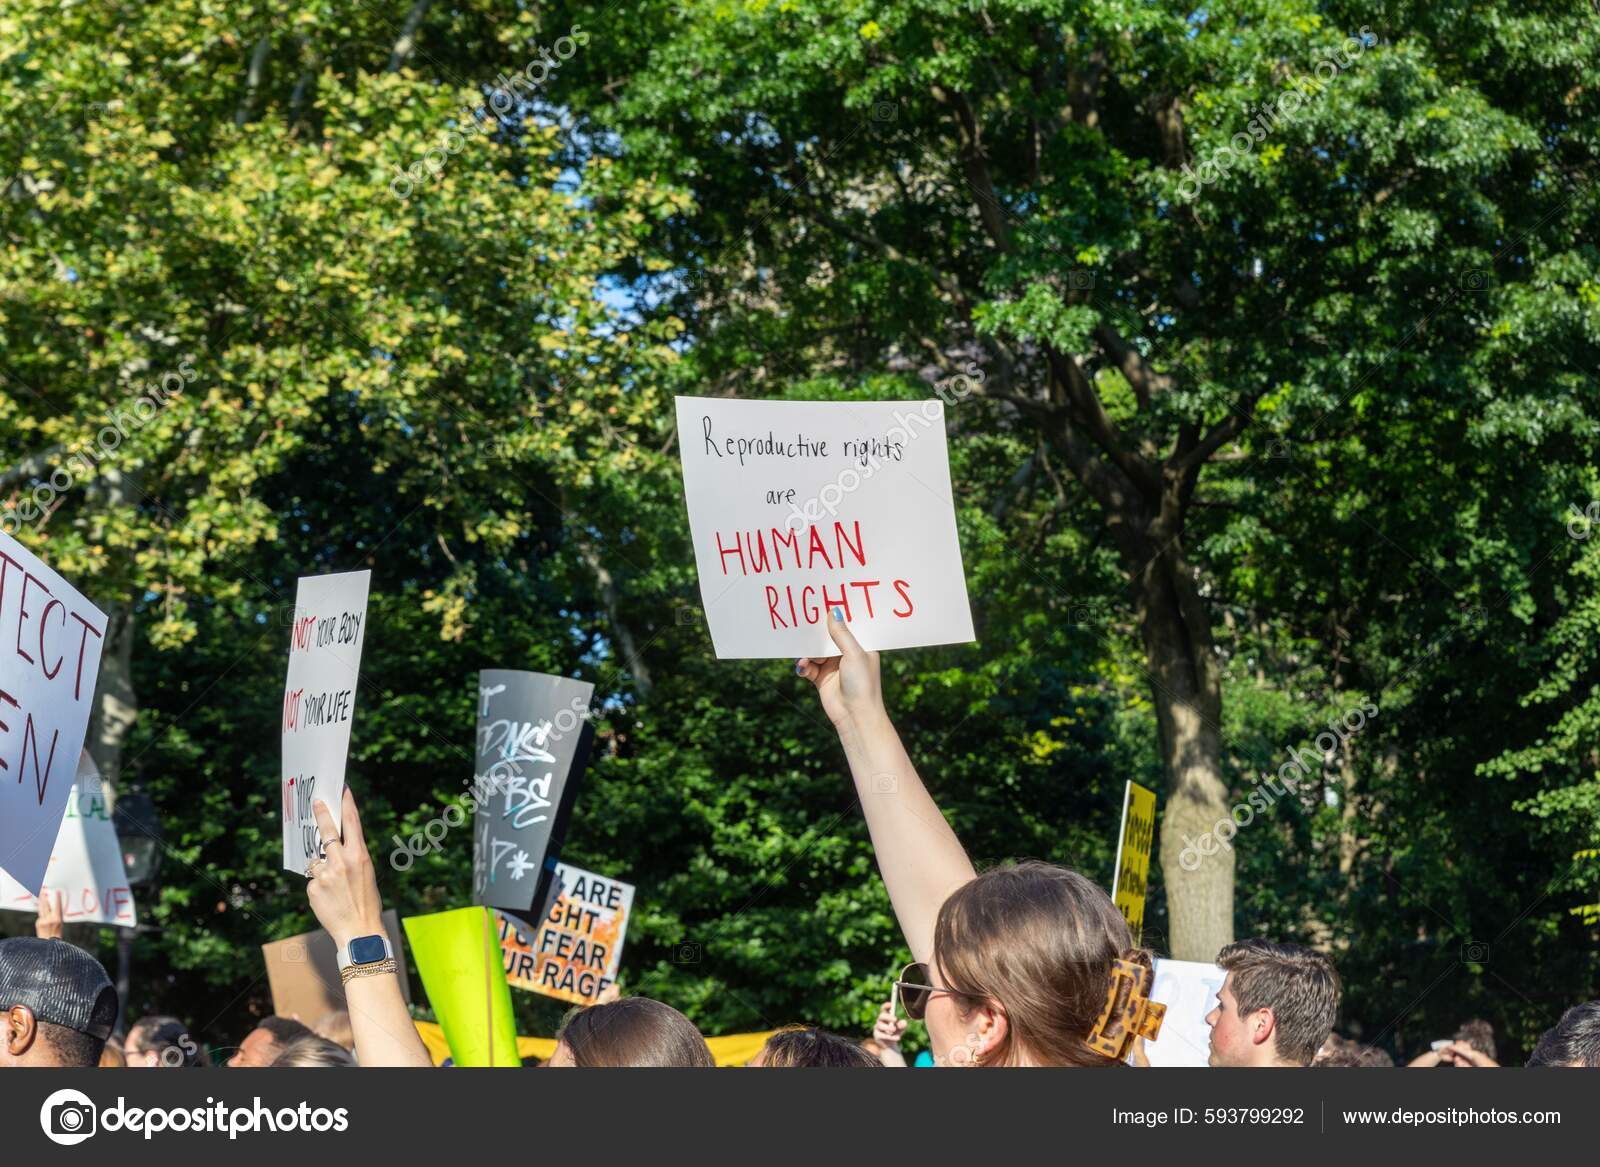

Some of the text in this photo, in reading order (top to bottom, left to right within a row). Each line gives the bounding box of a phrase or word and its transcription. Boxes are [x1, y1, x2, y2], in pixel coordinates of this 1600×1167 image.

[703, 415, 904, 466] Reproductive rights
[766, 487, 796, 505] are
[716, 520, 867, 576] HUMAN
[766, 579, 914, 630] RIGHTS
[292, 611, 362, 652] NOT YOUR BODY
[284, 688, 351, 733] NOT YOUR LIFE
[571, 875, 622, 911] ARE
[548, 900, 599, 934] GHT
[541, 929, 606, 970] FEAR
